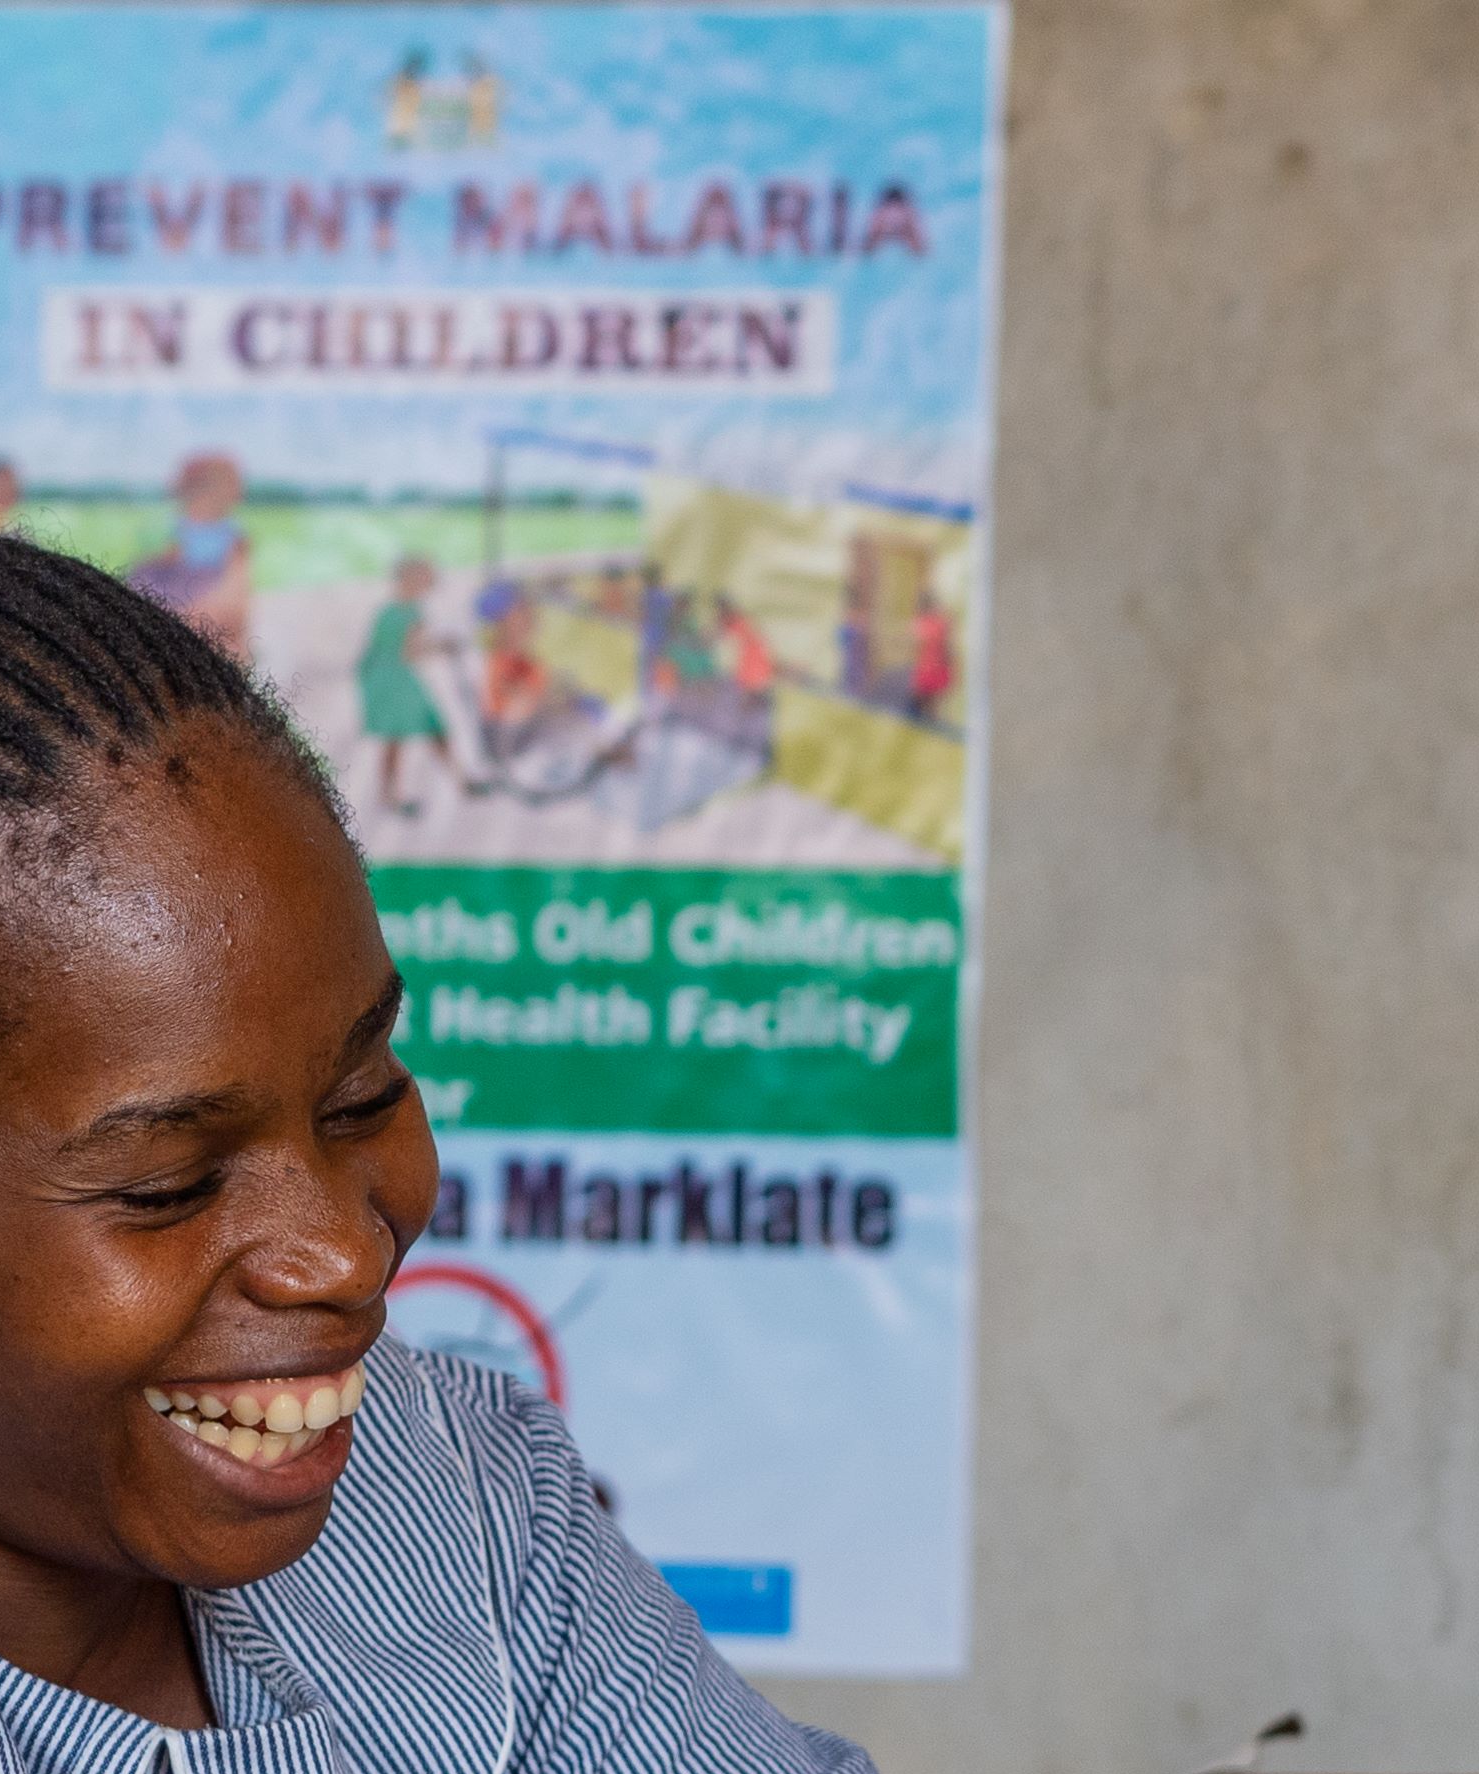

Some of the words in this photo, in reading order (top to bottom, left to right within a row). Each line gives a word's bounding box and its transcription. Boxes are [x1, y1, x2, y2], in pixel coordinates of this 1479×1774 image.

[451, 177, 928, 258] MALARIA
[77, 304, 185, 370] IN
[230, 302, 805, 372] CHILDREN
[532, 899, 654, 965] Old
[670, 902, 955, 968] Children
[430, 984, 652, 1046] Health
[667, 985, 910, 1065] Facility
[504, 1156, 895, 1249] Marklate
